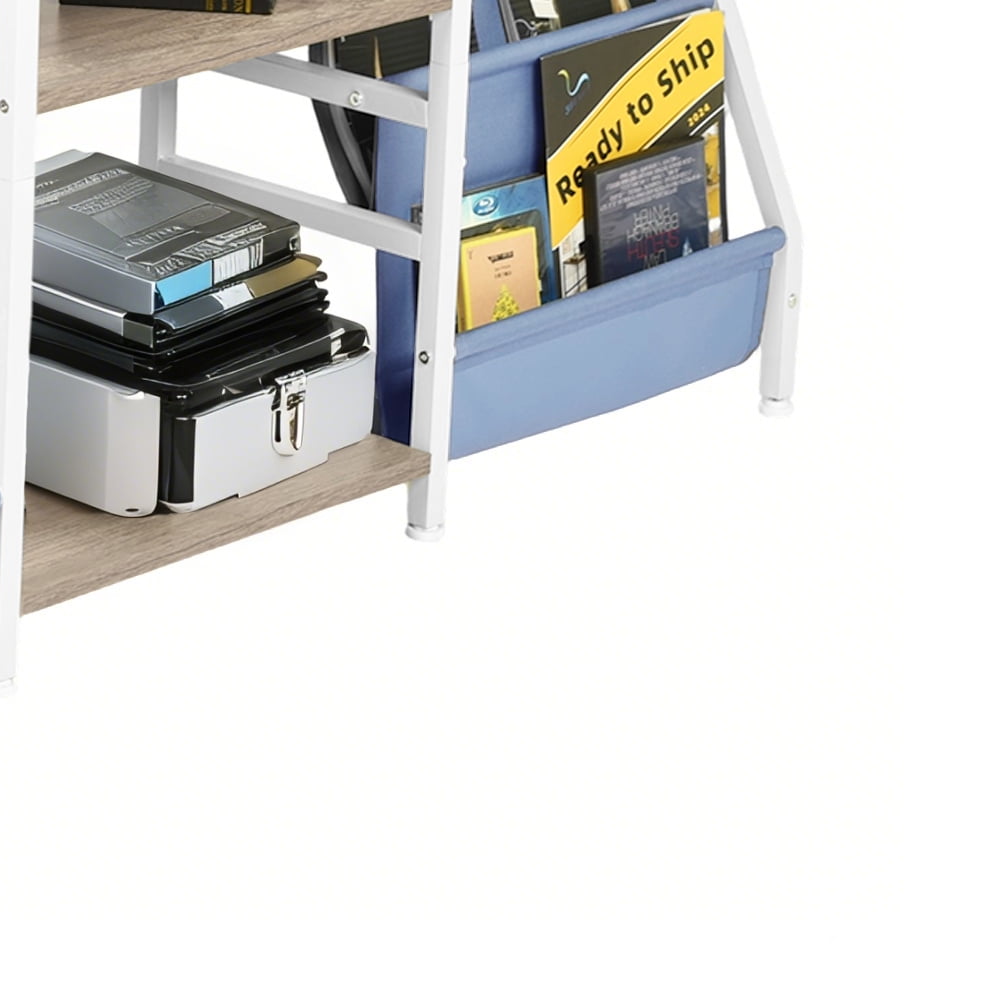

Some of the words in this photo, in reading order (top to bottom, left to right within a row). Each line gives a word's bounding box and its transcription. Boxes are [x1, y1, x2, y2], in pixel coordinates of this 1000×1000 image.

[555, 120, 622, 205] Ready
[626, 93, 653, 125] to
[657, 38, 714, 98] Ship
[687, 103, 711, 127] 2024
